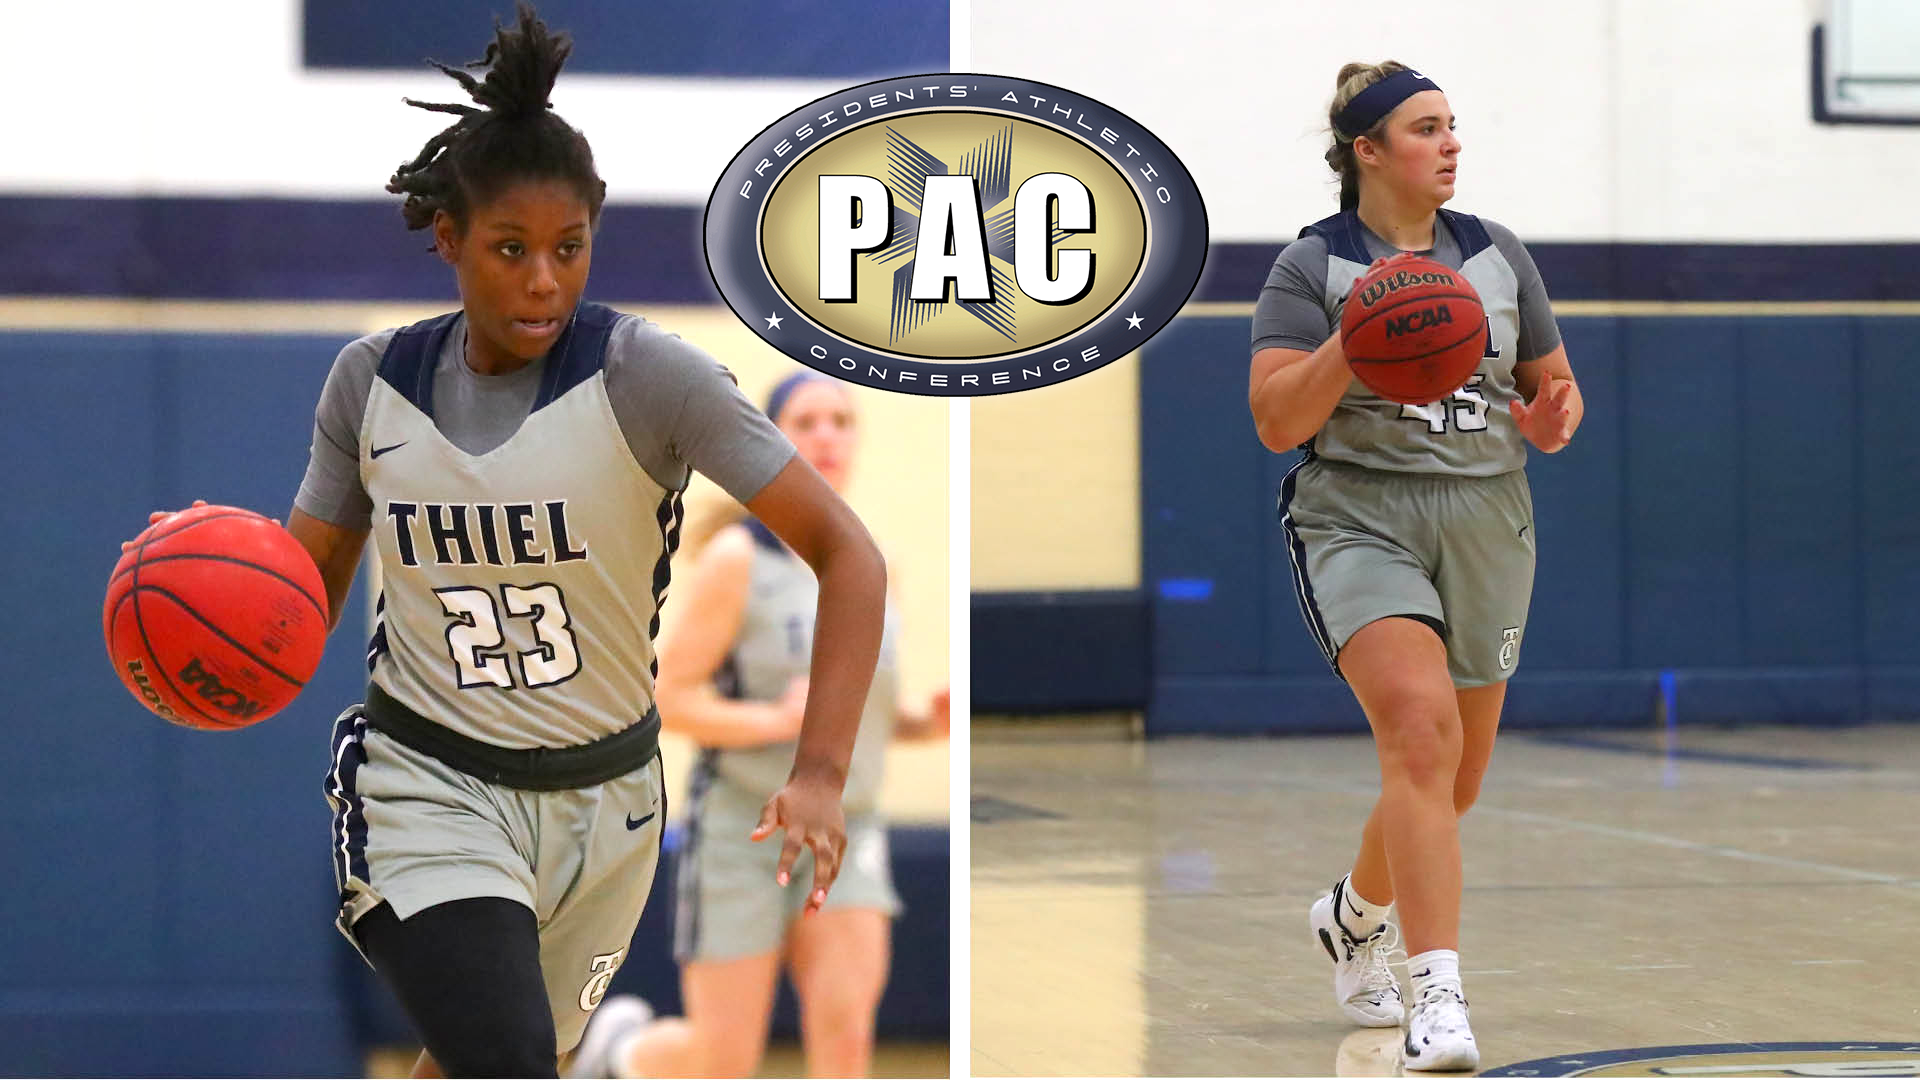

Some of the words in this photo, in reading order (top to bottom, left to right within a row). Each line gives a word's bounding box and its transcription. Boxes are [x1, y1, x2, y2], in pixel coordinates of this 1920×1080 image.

[1360, 271, 1456, 308] Wilson
[1385, 304, 1453, 341] NCAA
[387, 499, 588, 568] THIEL
[432, 581, 583, 690] 23
